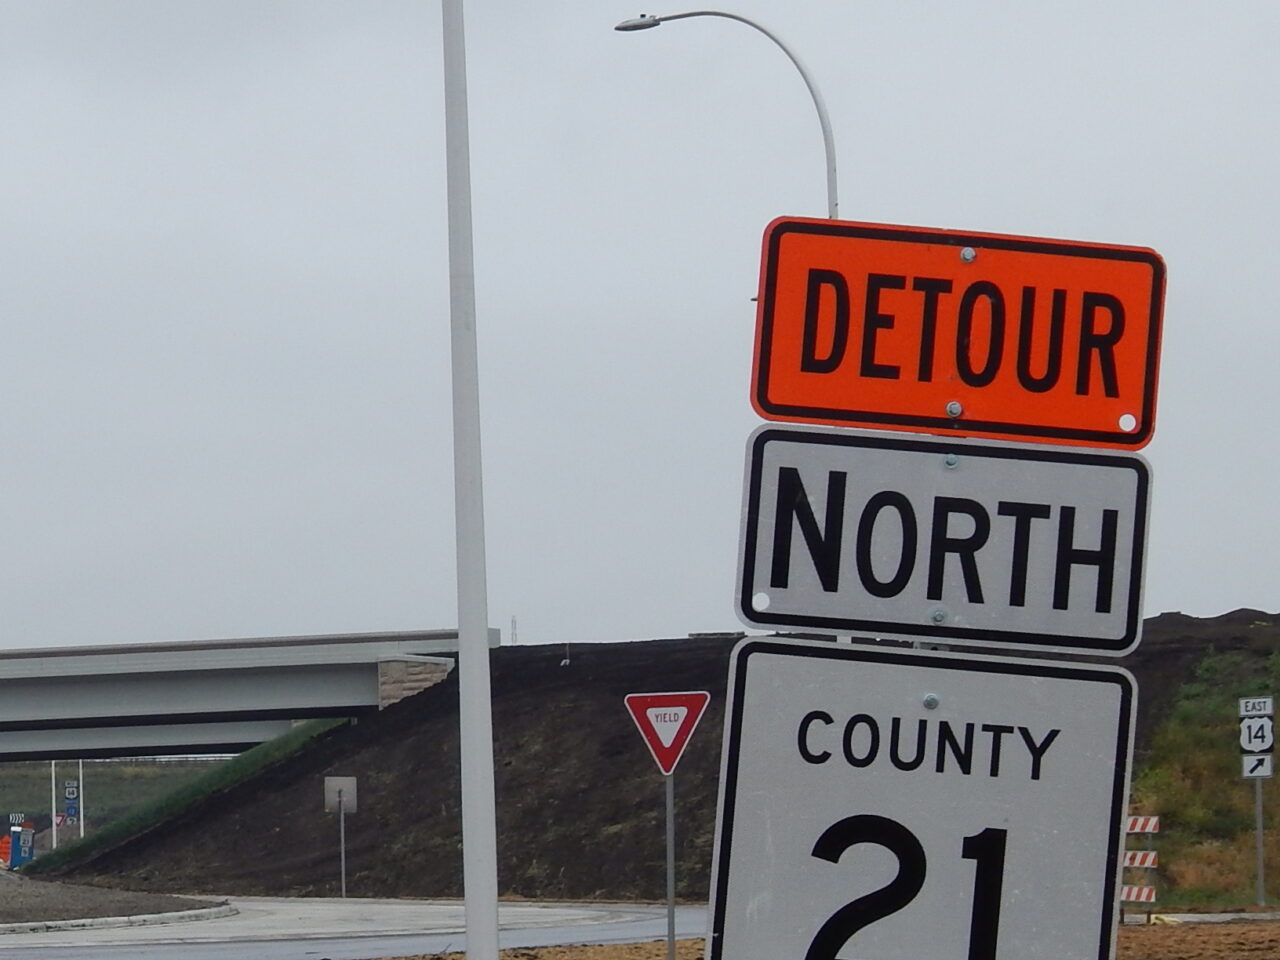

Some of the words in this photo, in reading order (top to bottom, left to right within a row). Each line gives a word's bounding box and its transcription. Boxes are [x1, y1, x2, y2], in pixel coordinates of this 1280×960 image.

[800, 267, 1126, 399] DETOUR
[770, 466, 1119, 614] NORTH
[654, 712, 680, 723] YIELD
[1244, 700, 1267, 713] EAST
[797, 709, 1061, 781] COUNTY
[1246, 723, 1266, 744] 14
